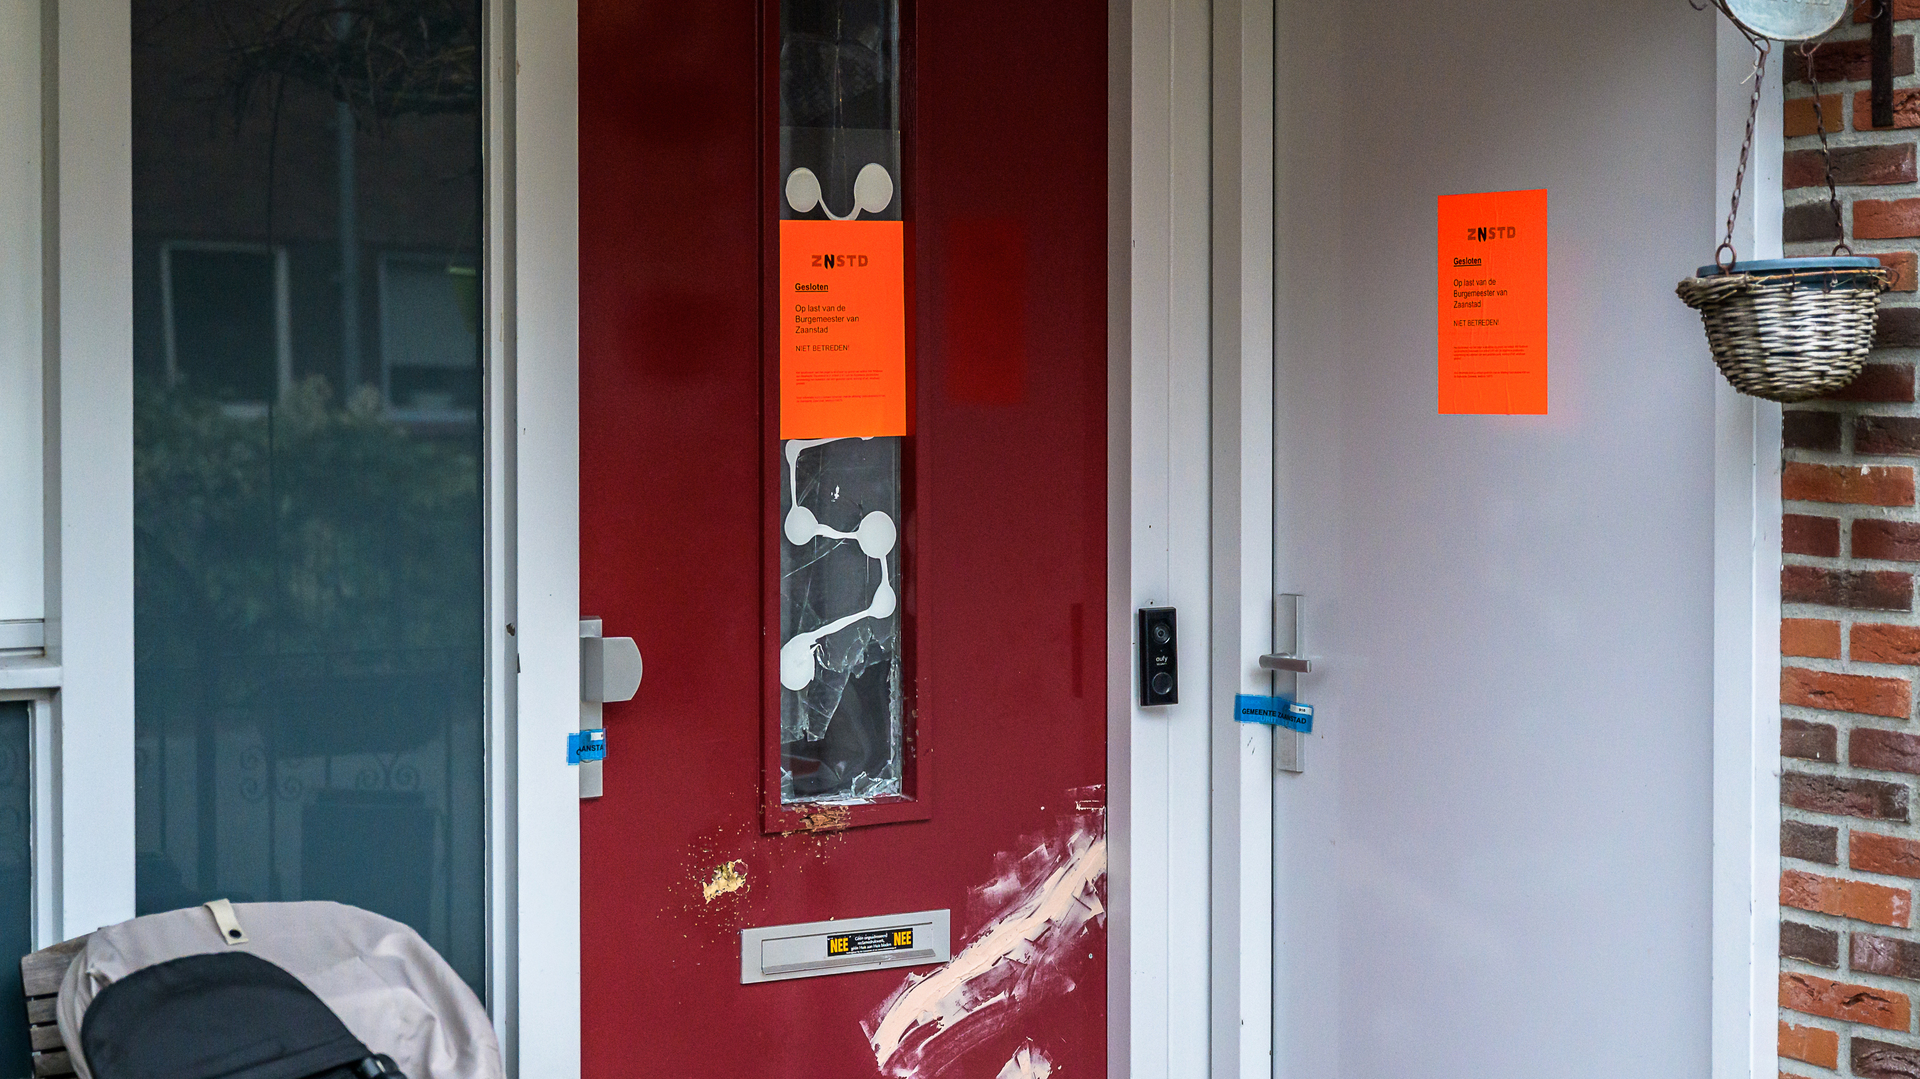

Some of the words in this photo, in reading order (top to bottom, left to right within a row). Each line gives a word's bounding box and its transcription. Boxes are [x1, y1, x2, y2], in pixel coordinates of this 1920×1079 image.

[1467, 226, 1516, 242] ZNSTD
[811, 254, 868, 269] ZNSTD
[1453, 257, 1482, 267] Gesloten
[794, 282, 829, 292] Gesloten
[1453, 279, 1463, 288] Op
[1488, 278, 1496, 286] de
[1453, 290, 1495, 299] Burgemeester
[795, 304, 806, 313] Op
[807, 304, 820, 312] last
[836, 304, 846, 312] de
[1453, 300, 1482, 308] Zaanstad
[795, 315, 845, 324] Burgemeester
[795, 326, 829, 334] Zaanstad
[1241, 708, 1277, 717] GEMEENTE
[1277, 711, 1307, 724] ZAANSTAD
[893, 931, 911, 946] NEE
[830, 938, 849, 953] NEE
